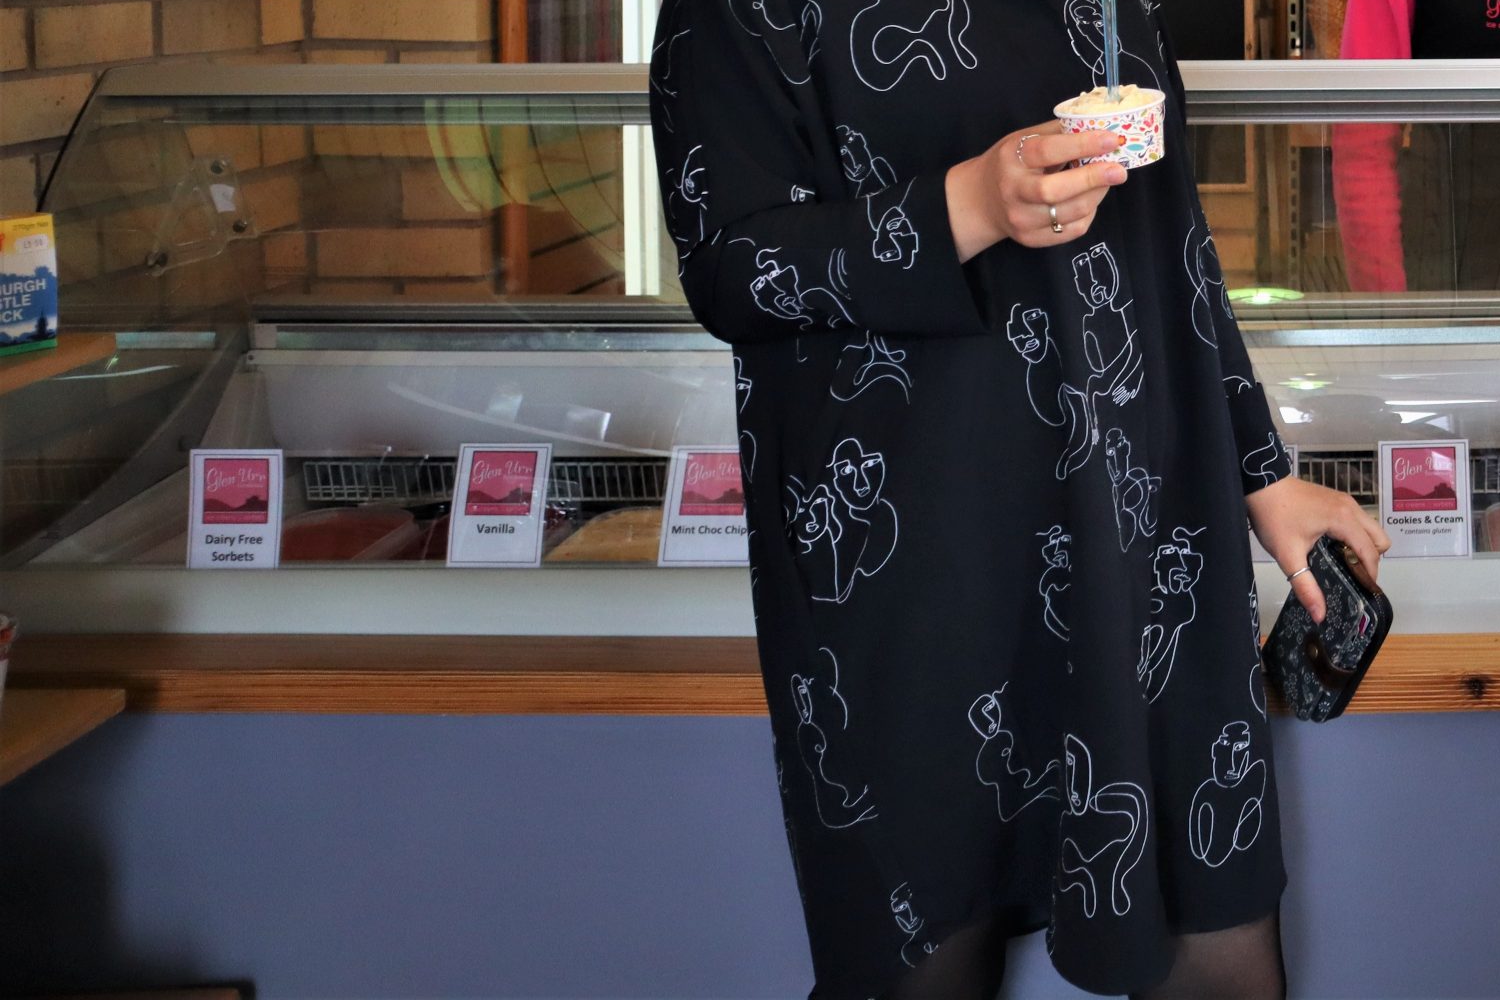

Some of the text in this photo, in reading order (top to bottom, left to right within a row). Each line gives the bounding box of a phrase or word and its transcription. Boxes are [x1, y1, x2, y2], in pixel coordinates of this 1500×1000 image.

[0, 278, 46, 297] URGH
[0, 308, 24, 323] CK
[472, 460, 502, 484] Glen
[686, 462, 716, 485] Glen
[1394, 457, 1423, 481] Glen
[206, 467, 236, 492] Glen
[1386, 515, 1464, 526] Cookies & Cream
[476, 524, 515, 535] Vanilla
[671, 525, 748, 537] Mint Choc Chip
[1432, 528, 1452, 536] gluten
[205, 534, 263, 547] Dairy Free
[211, 551, 254, 562] Sorbets
